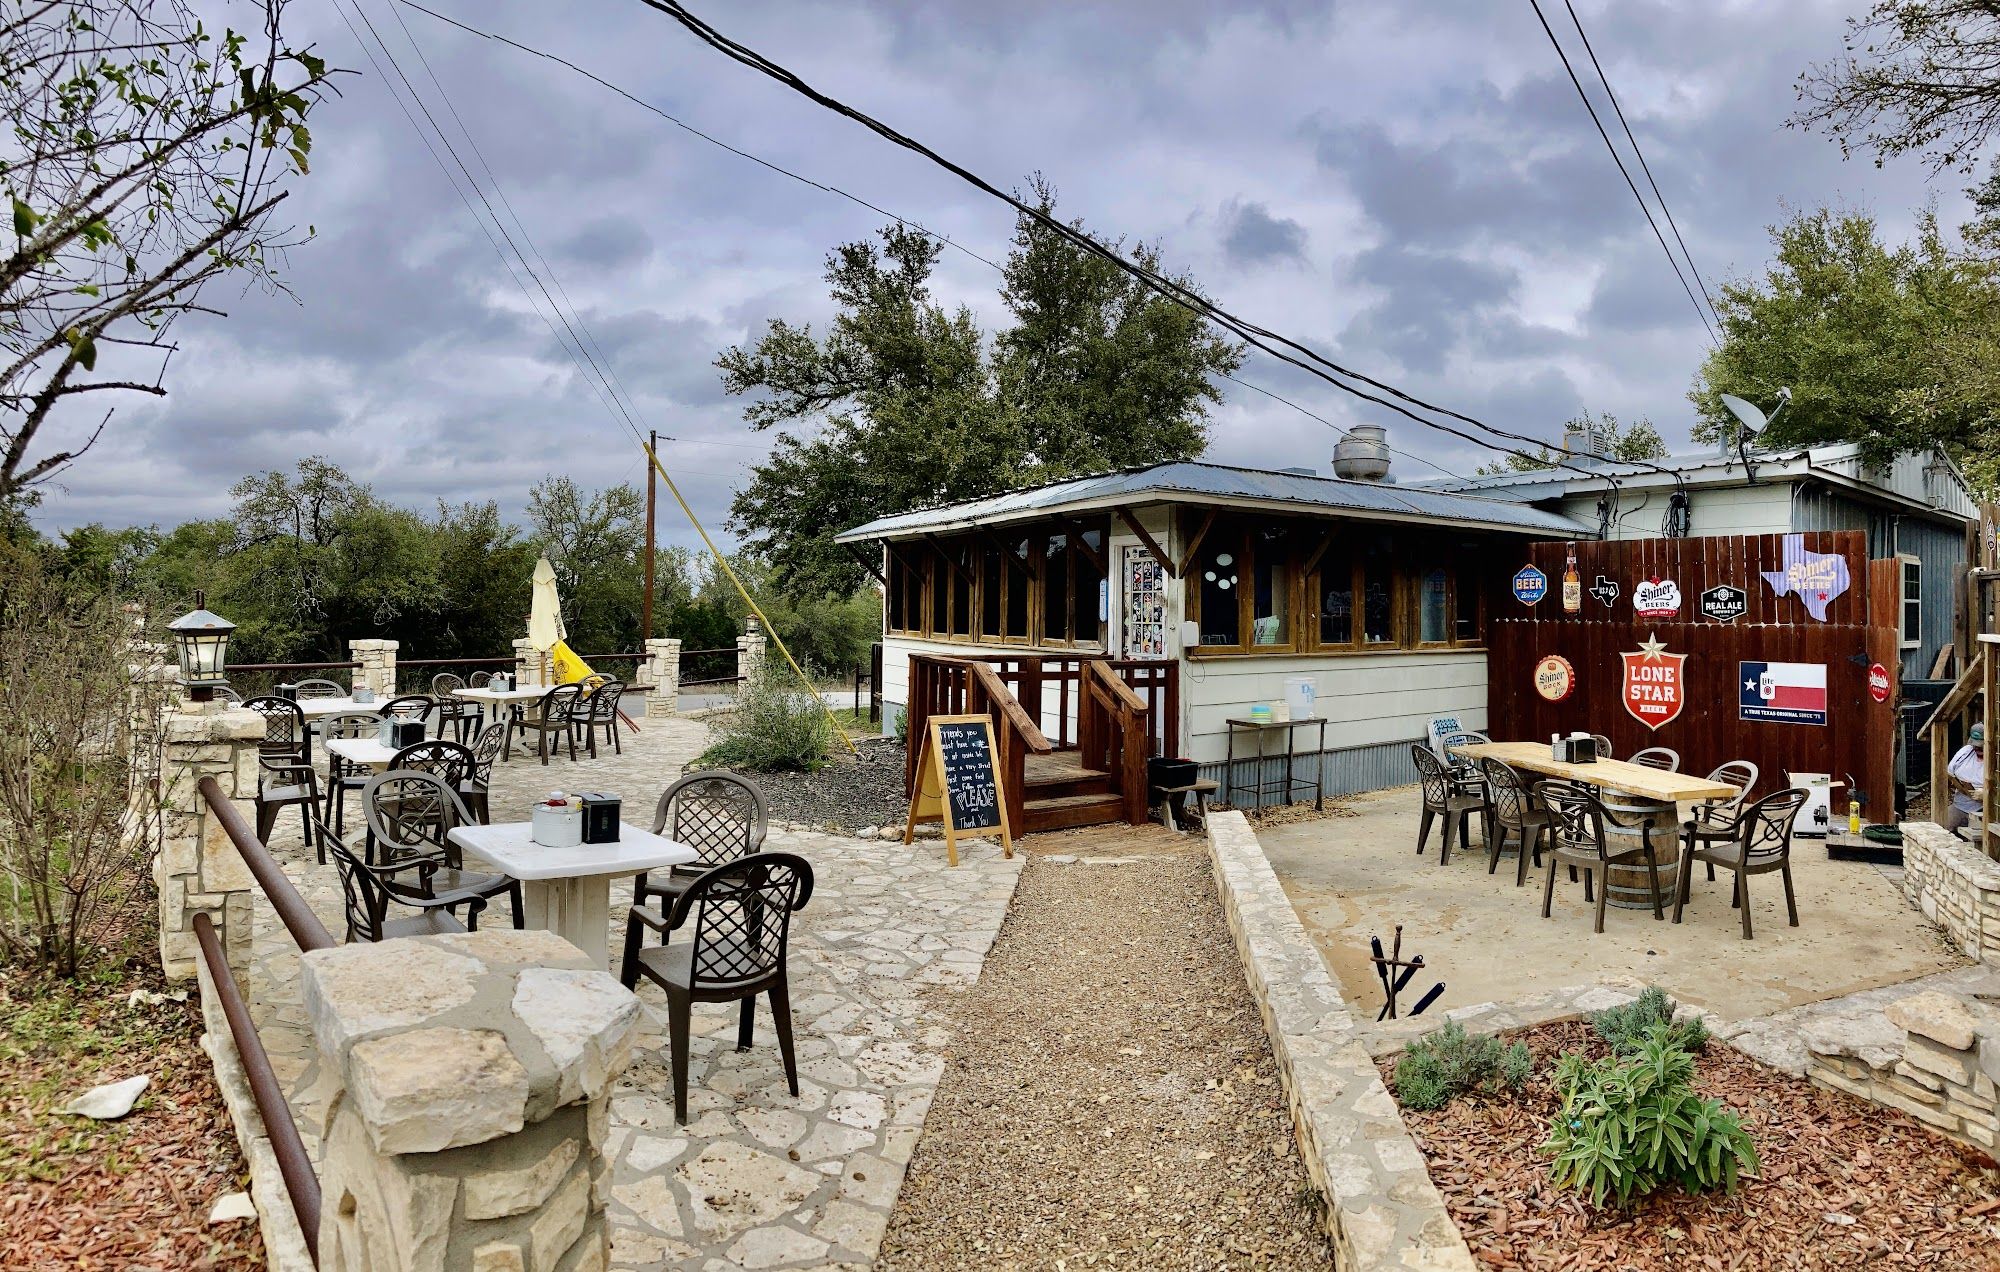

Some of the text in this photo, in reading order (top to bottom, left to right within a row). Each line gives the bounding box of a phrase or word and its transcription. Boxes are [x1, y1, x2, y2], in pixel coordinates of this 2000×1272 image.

[1789, 558, 1835, 582] Shiner
[1516, 578, 1543, 590] BEER
[1640, 583, 1673, 603] Shiner
[1705, 601, 1743, 610] REAL ALE
[1539, 671, 1564, 685] Shiner
[1631, 665, 1675, 683] LONE
[1762, 677, 1774, 686] Lite
[1631, 684, 1675, 702] STAR
[956, 787, 994, 811] PLEASE
[959, 816, 977, 829] Thank
